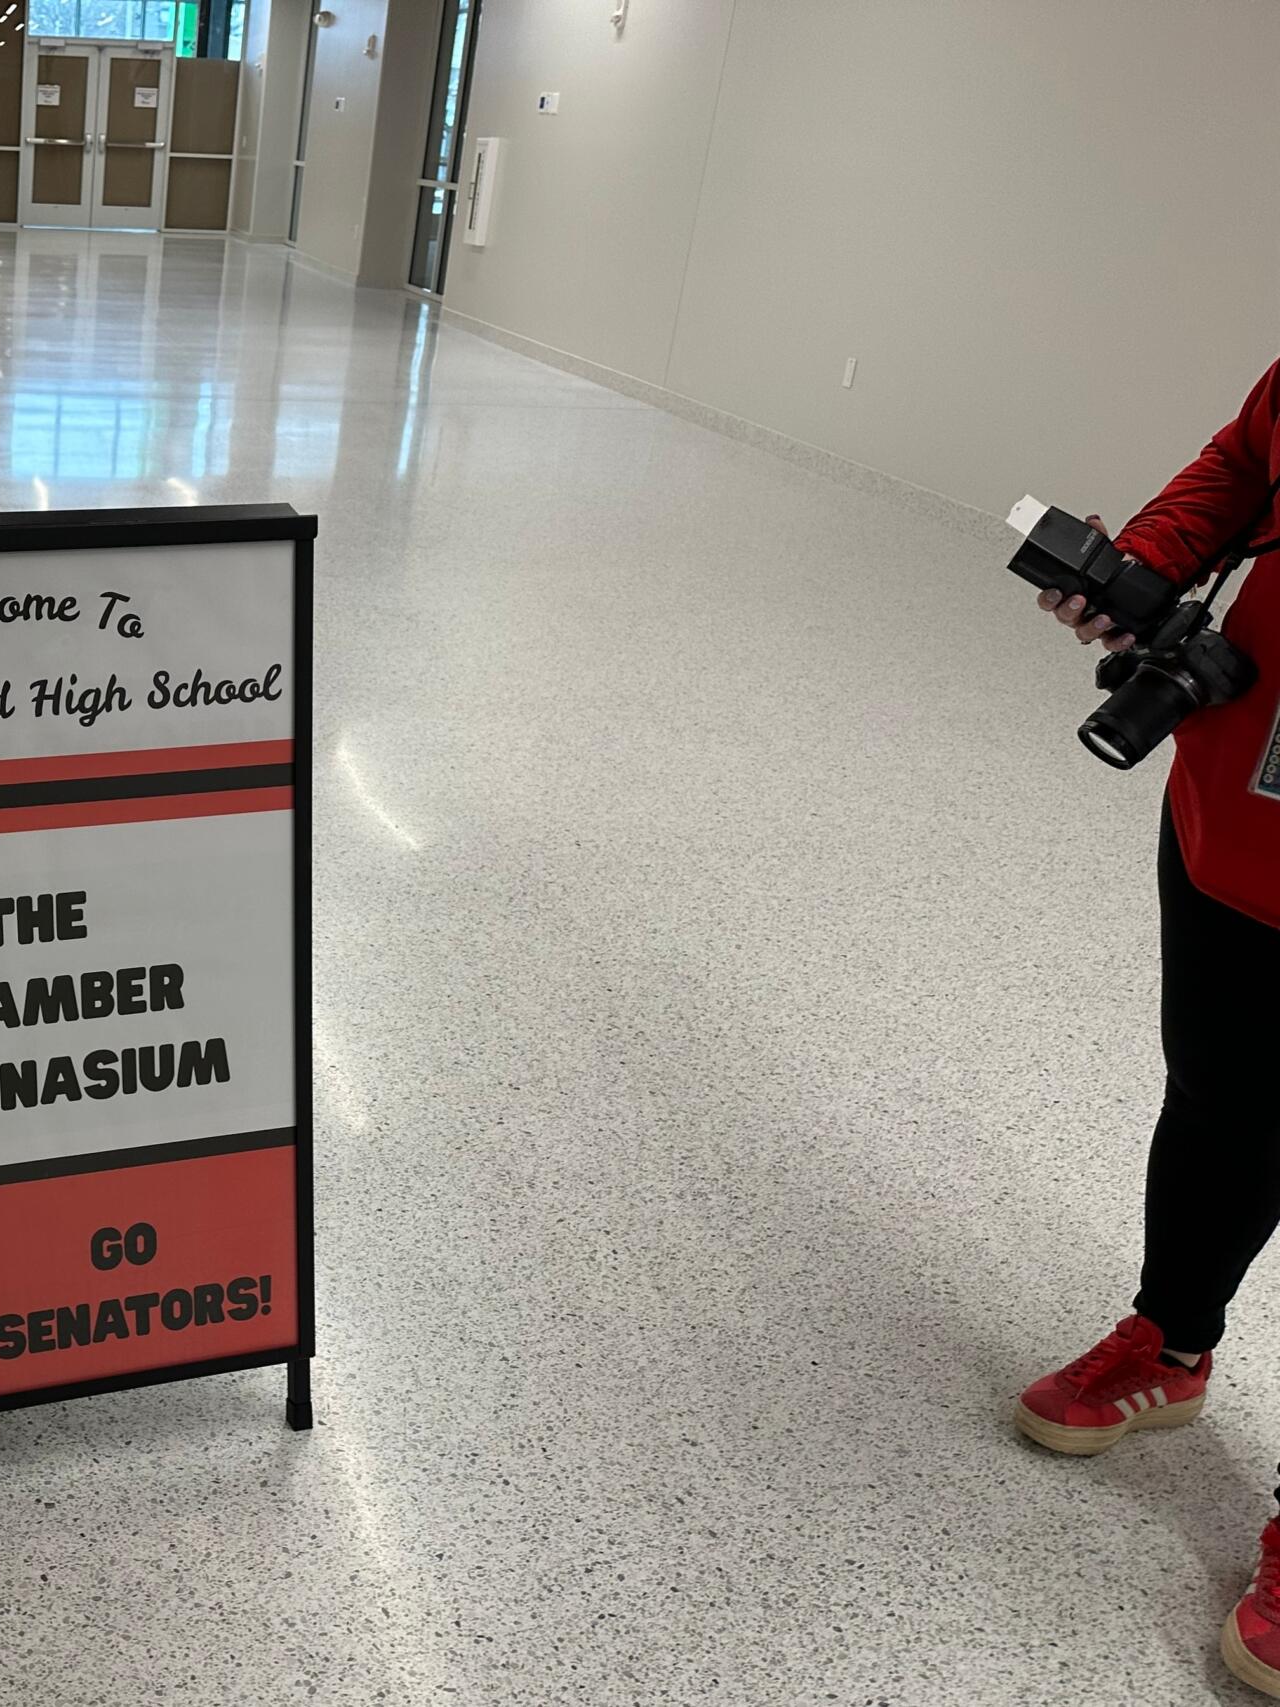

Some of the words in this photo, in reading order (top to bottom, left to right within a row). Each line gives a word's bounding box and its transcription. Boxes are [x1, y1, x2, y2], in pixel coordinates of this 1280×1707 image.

[99, 591, 144, 639] To
[30, 674, 132, 727] High
[147, 663, 283, 707] School
[90, 1222, 157, 1271] GO
